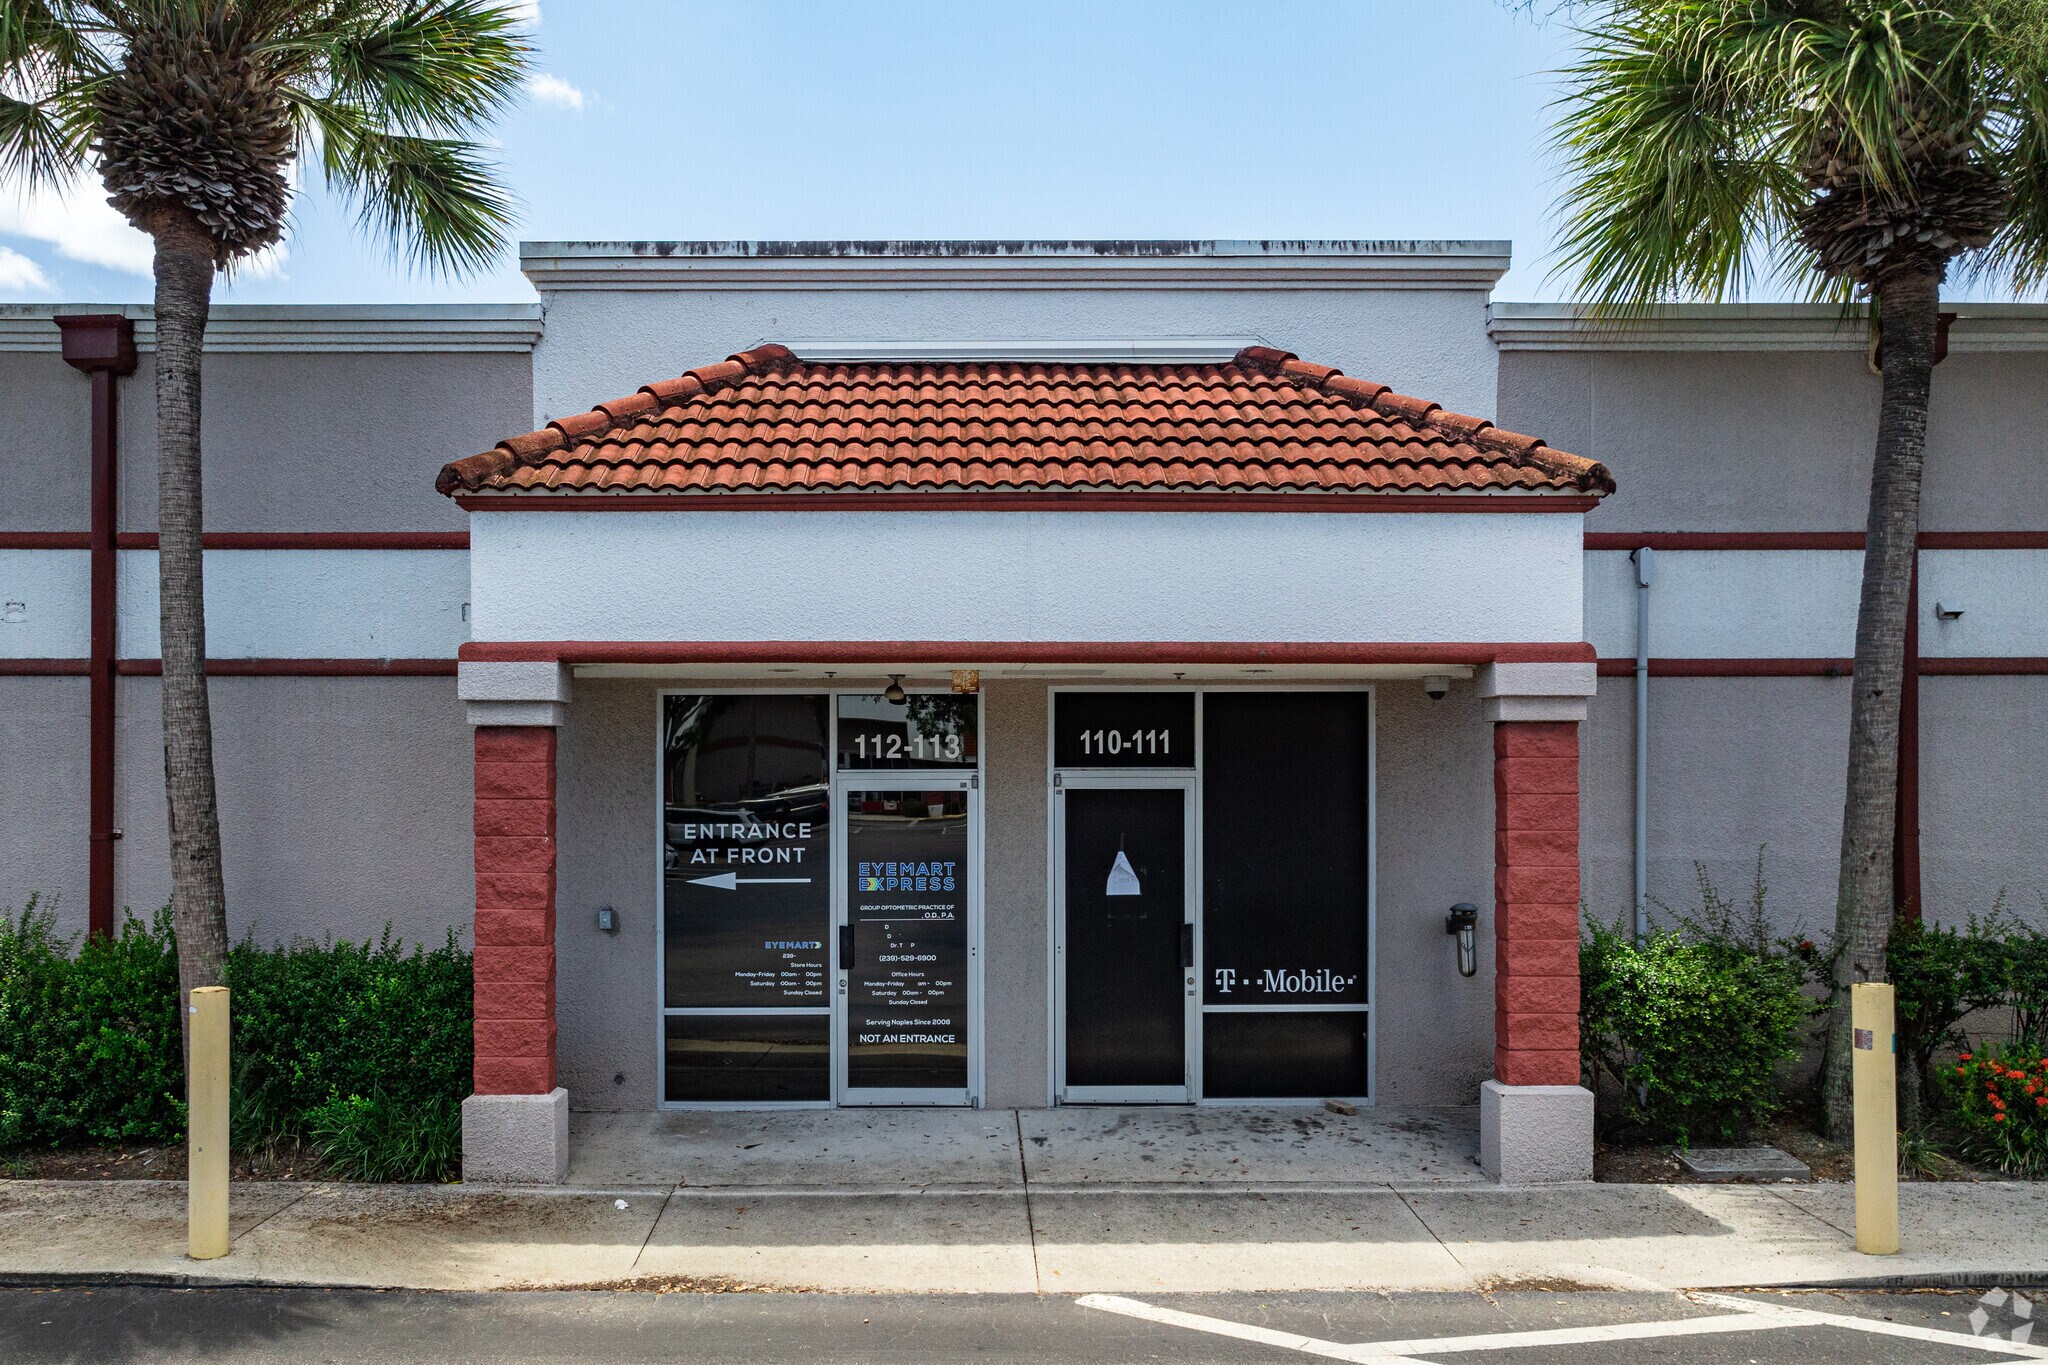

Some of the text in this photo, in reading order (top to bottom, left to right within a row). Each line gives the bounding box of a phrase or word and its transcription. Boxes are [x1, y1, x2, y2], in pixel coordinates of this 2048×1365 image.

[854, 734, 961, 760] 112-113
[1080, 729, 1170, 755] 110-111
[684, 823, 811, 840] ENTRANCE
[690, 847, 806, 864] AT FRONT
[859, 862, 956, 876] EYEMART
[859, 877, 955, 891] EXPRESS
[764, 941, 815, 949] EYEMART
[865, 1019, 891, 1027] Serving
[859, 1034, 955, 1043] NOT AN ENTRANCE
